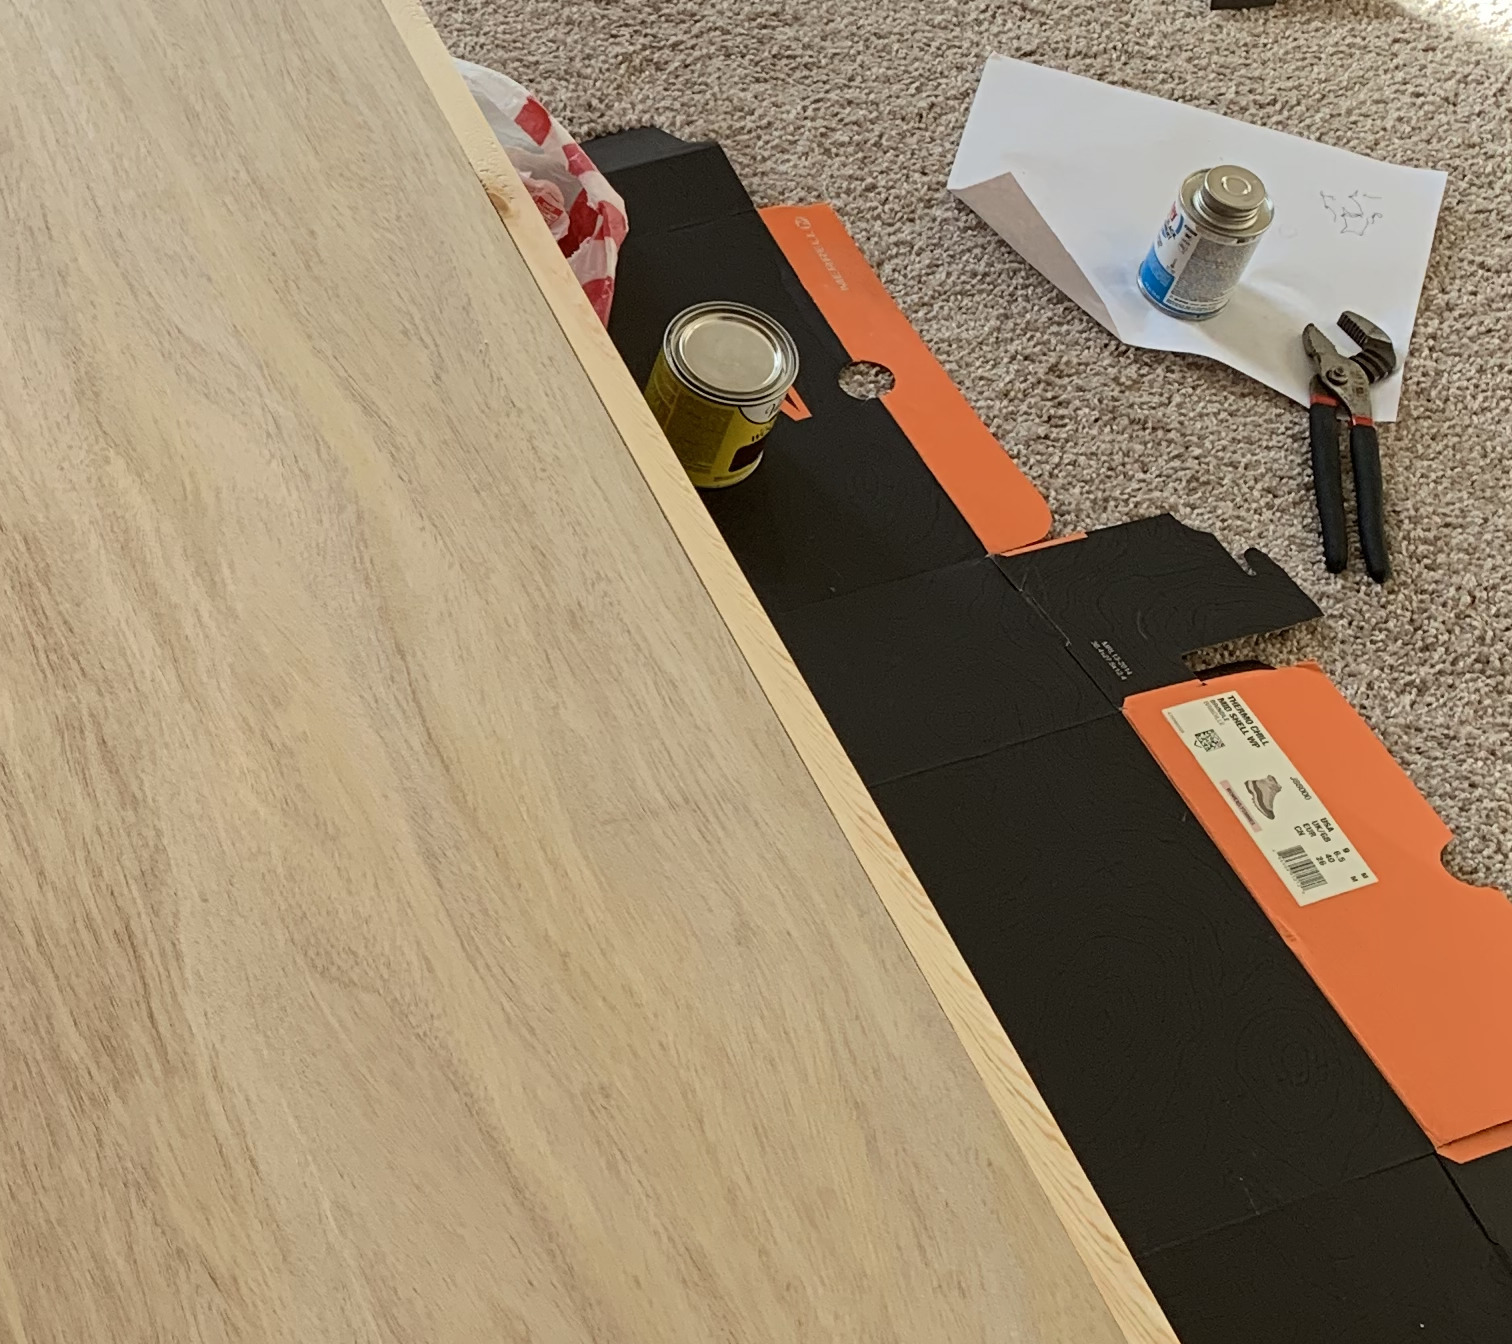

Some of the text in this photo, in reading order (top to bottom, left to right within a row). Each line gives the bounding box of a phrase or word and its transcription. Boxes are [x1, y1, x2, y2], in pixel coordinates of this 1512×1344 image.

[1227, 694, 1270, 747] THERMO CHILL
[1228, 712, 1250, 736] SHELL
[1246, 735, 1261, 749] WP
[1294, 825, 1306, 837] CN
[1302, 822, 1317, 838] EUR
[1320, 817, 1335, 833] USA
